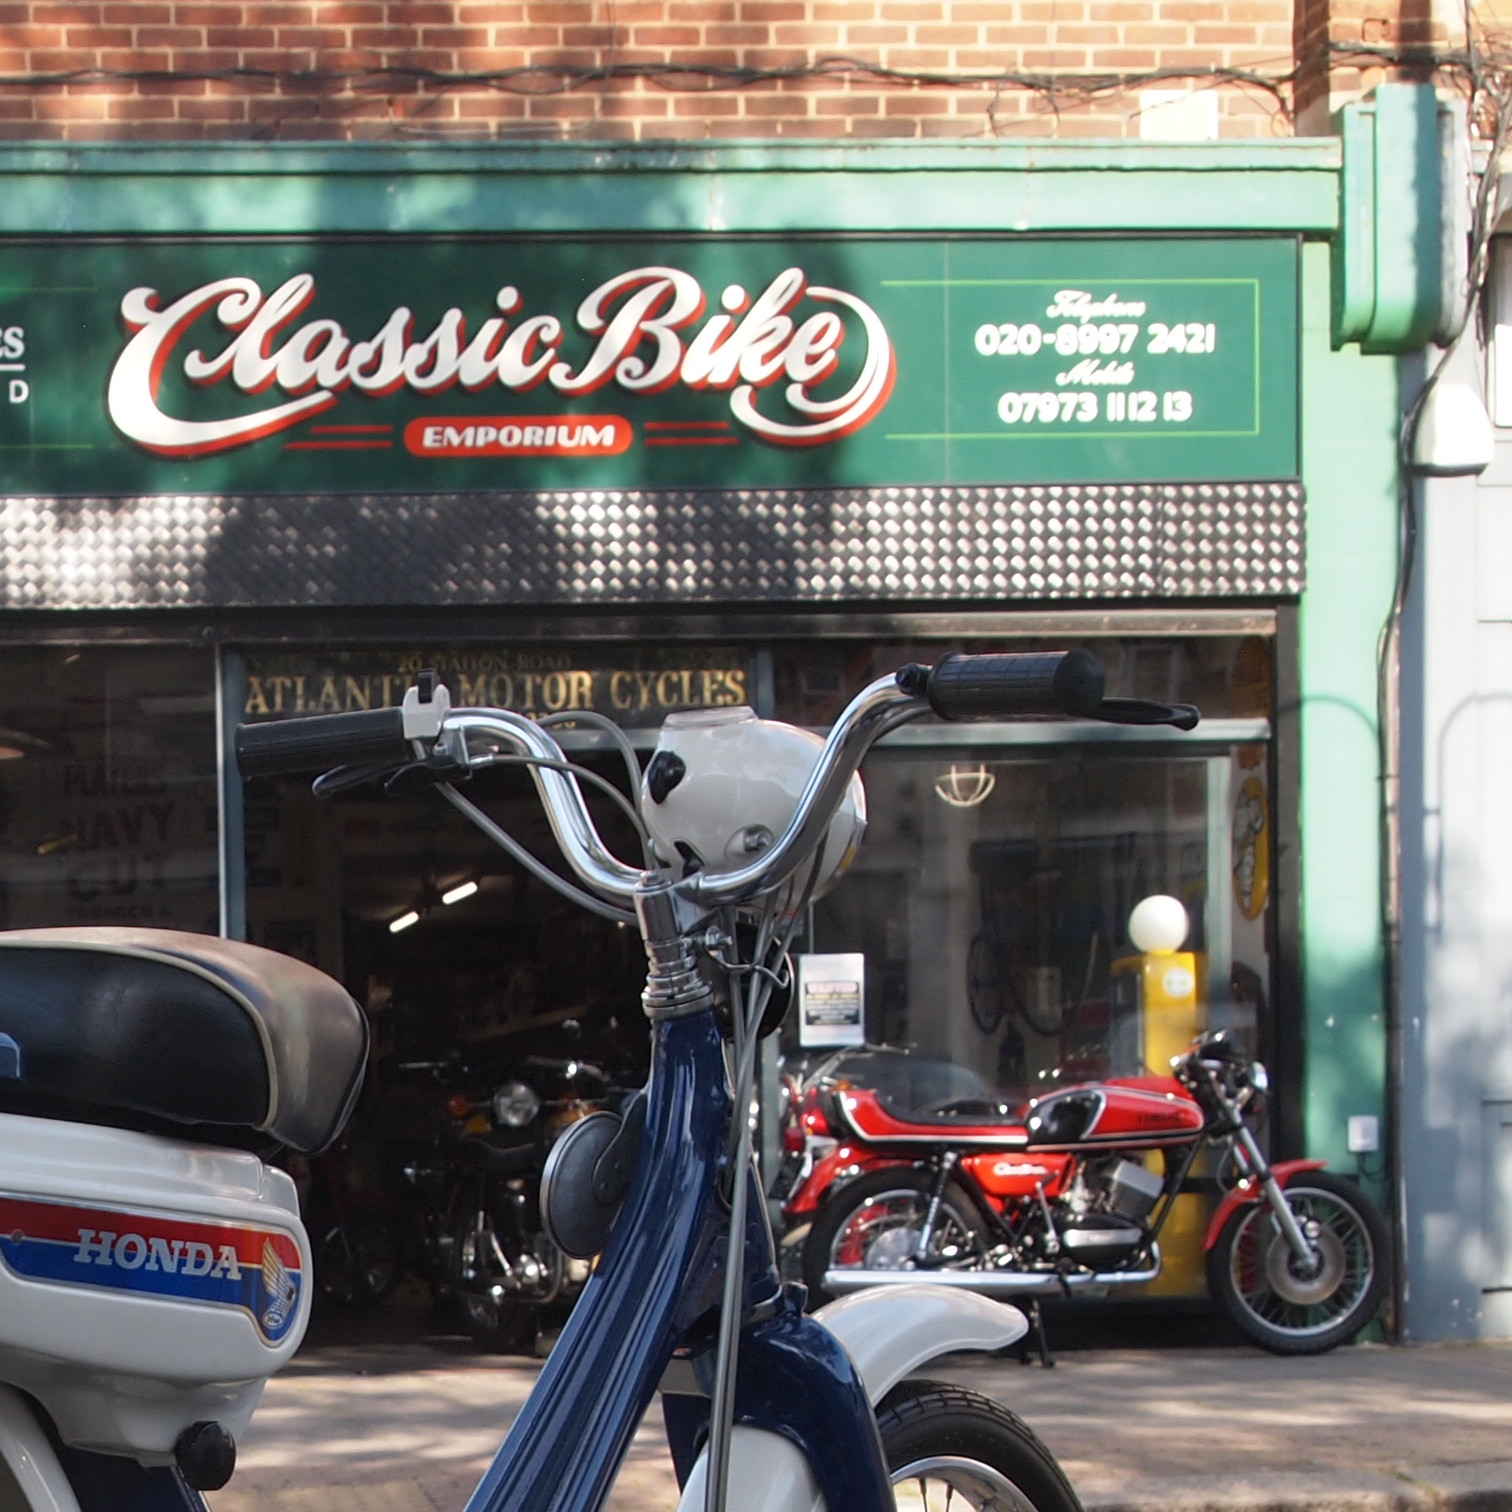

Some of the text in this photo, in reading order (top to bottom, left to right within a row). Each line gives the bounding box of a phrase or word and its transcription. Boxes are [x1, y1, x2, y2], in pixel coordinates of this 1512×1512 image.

[1045, 289, 1147, 324] Telephone
[974, 323, 1215, 356] 020-8997 2421
[107, 266, 896, 459] Classic Bike
[1055, 358, 1135, 386] Mobile
[997, 391, 1099, 423] 07973
[421, 424, 616, 450] EMPORIUM
[244, 667, 747, 715] ATLANT MOTOR CYCLES
[73, 1228, 243, 1281] HONDA
